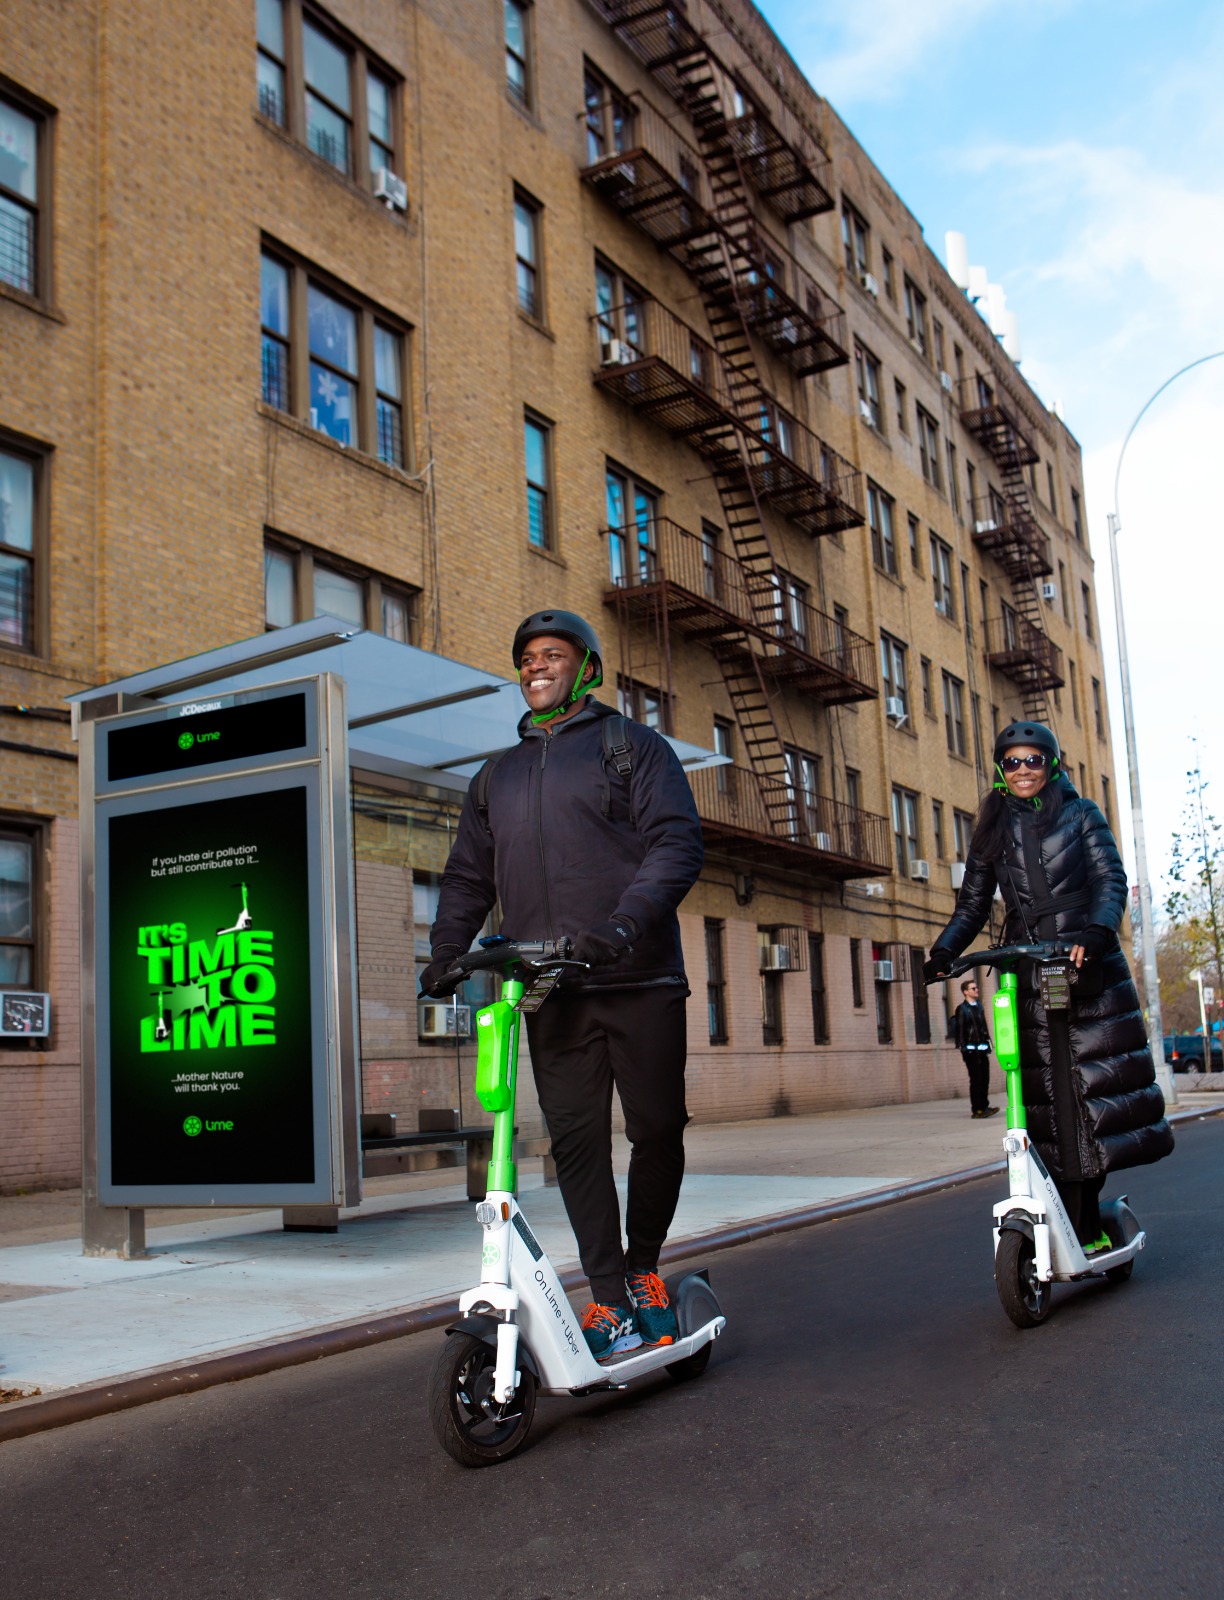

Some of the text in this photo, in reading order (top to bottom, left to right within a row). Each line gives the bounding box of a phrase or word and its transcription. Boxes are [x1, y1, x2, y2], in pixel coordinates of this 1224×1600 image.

[180, 701, 221, 716] JCDecaux
[151, 867, 166, 877] but
[168, 864, 183, 875] still
[184, 859, 233, 872] contribute
[235, 857, 245, 866] to
[152, 845, 257, 868] If you hate air pollution
[139, 922, 188, 947] IT'S
[137, 930, 274, 985] TIME
[198, 964, 277, 1009] TO
[140, 1004, 277, 1053] LIME
[211, 1071, 244, 1080] Nature
[174, 1082, 240, 1094] will thank you.
[534, 1270, 580, 1356] On Lime + Uber
